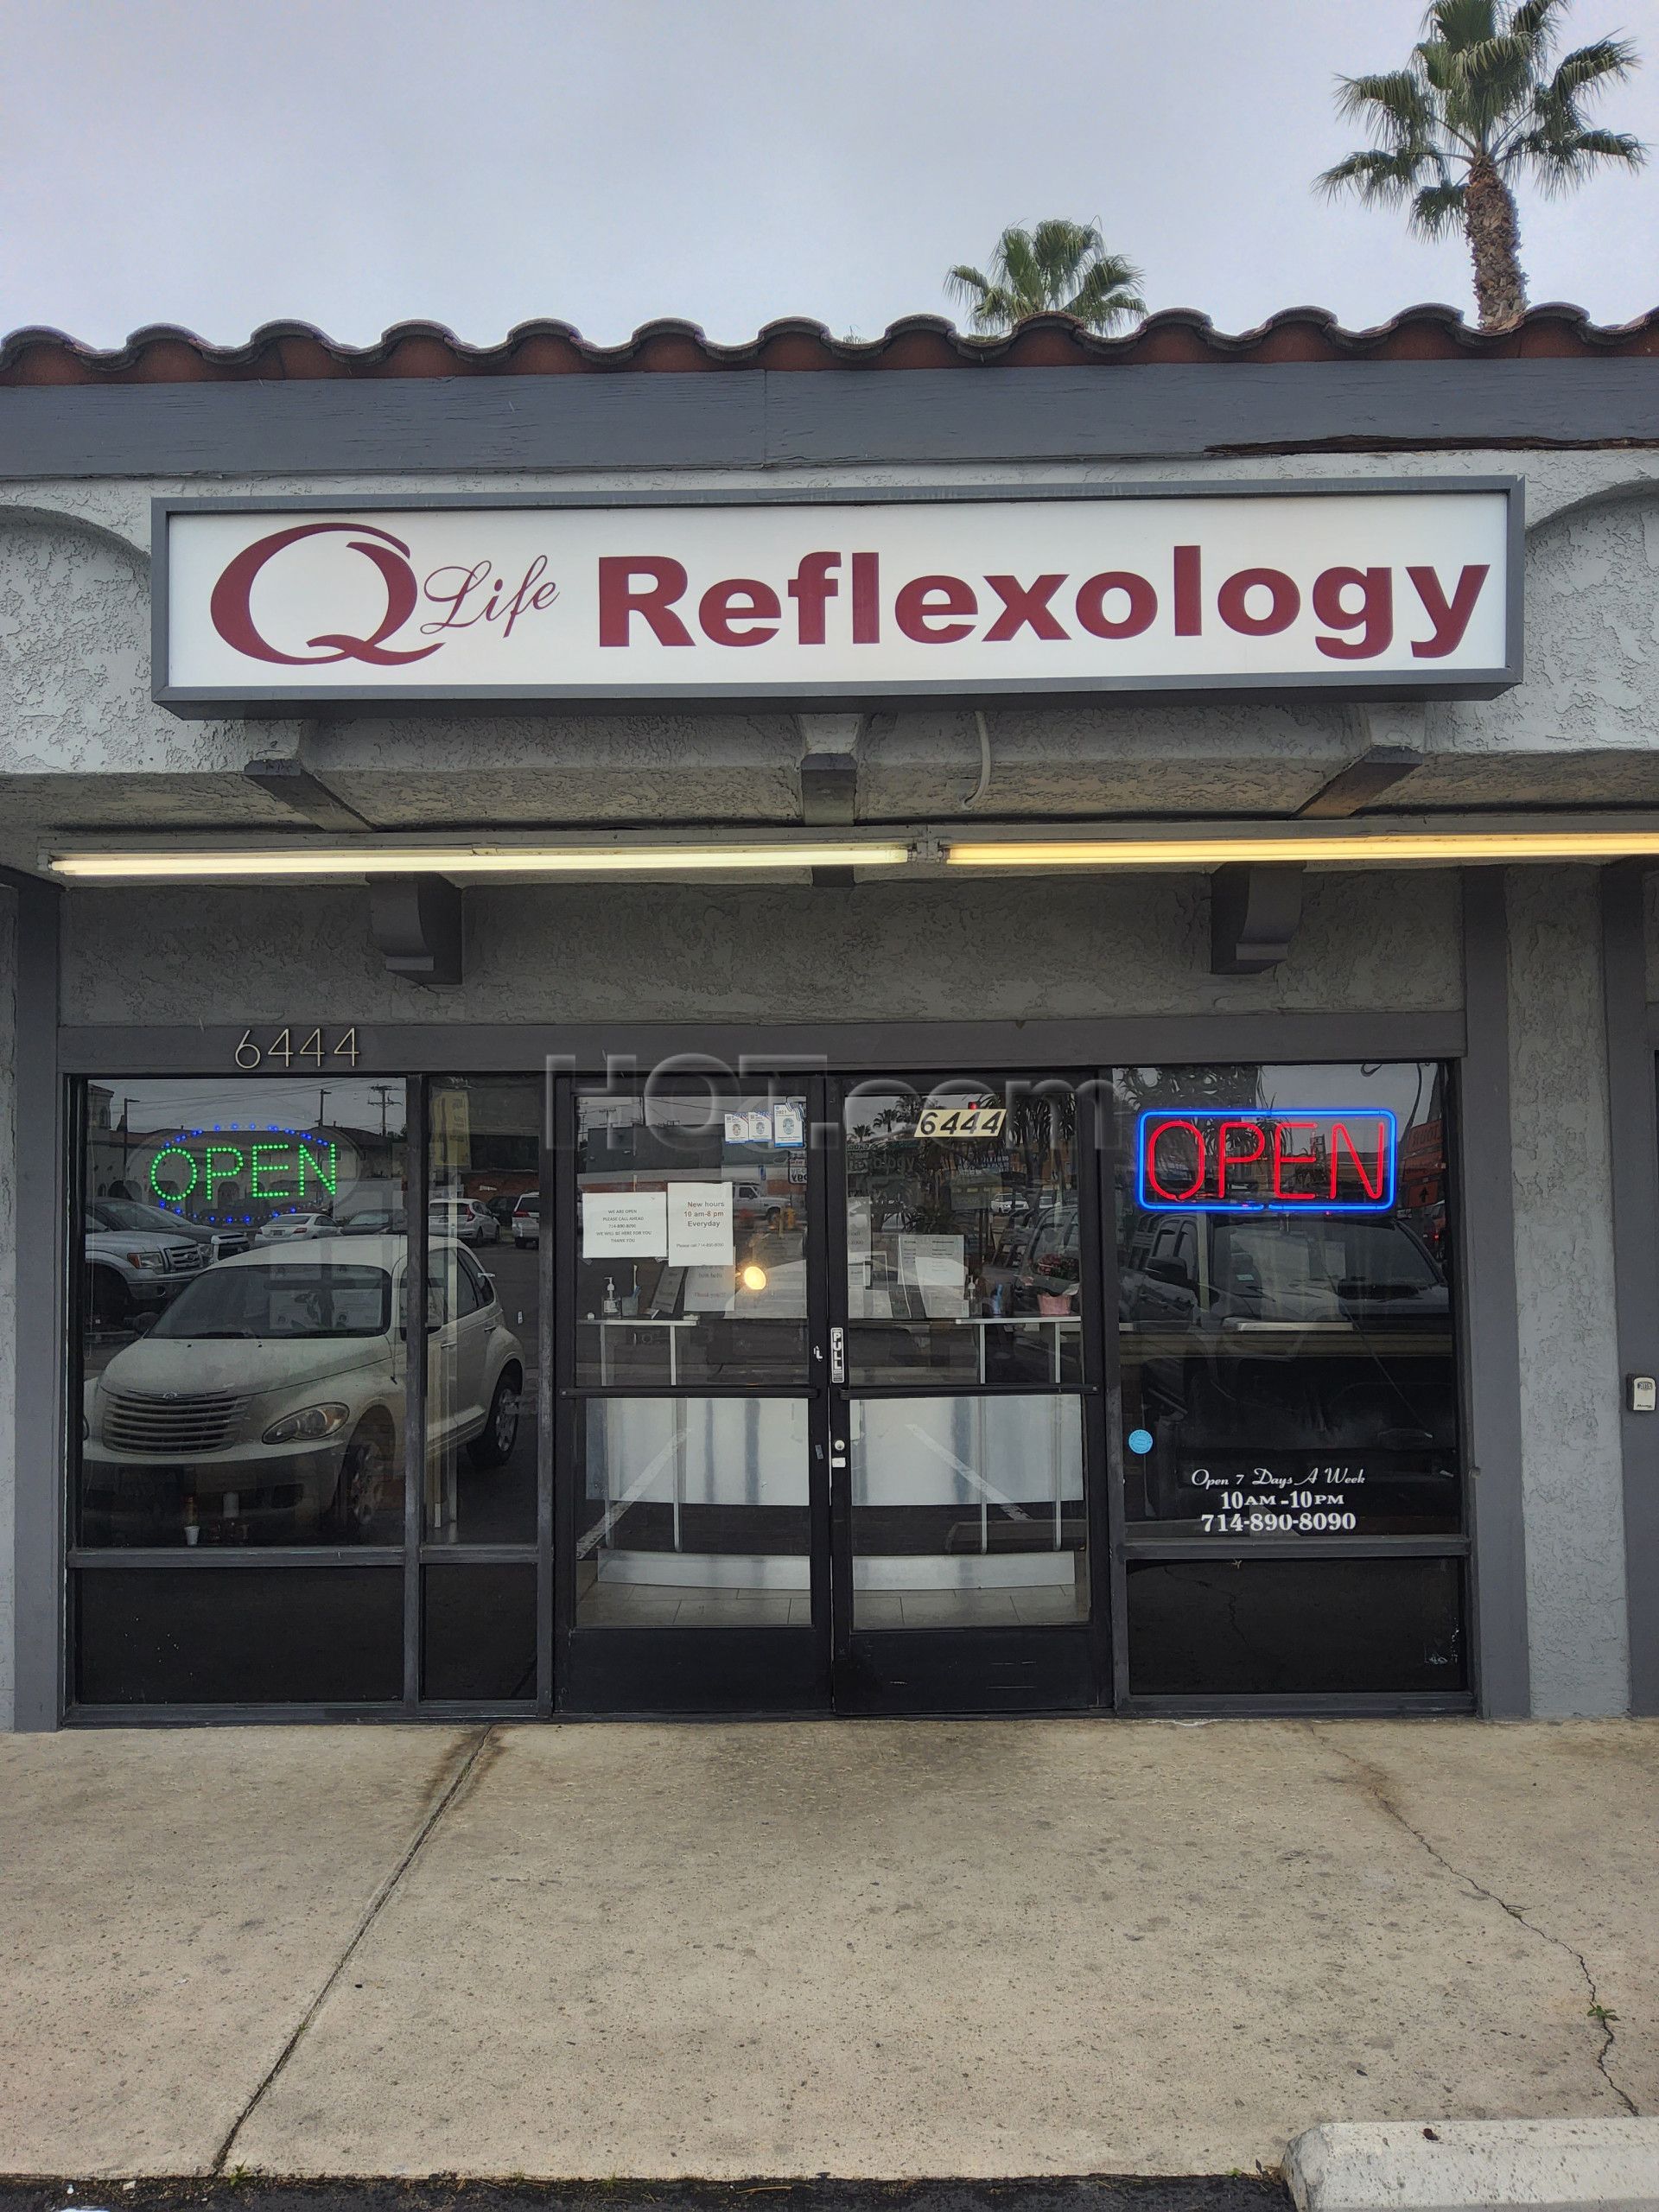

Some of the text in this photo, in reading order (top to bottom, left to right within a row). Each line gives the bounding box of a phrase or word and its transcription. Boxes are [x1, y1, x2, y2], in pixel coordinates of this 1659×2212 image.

[210, 522, 1490, 666] Q Life Reflexology
[235, 1028, 359, 1069] 6444
[920, 1111, 1002, 1135] 6444
[150, 1143, 336, 1201] OPEN
[1147, 1120, 1385, 1200] OPEN
[833, 1332, 842, 1370] PULL
[1192, 1467, 1365, 1490] Open 7 Days A Week
[1201, 1513, 1356, 1532] 714-890-8090
